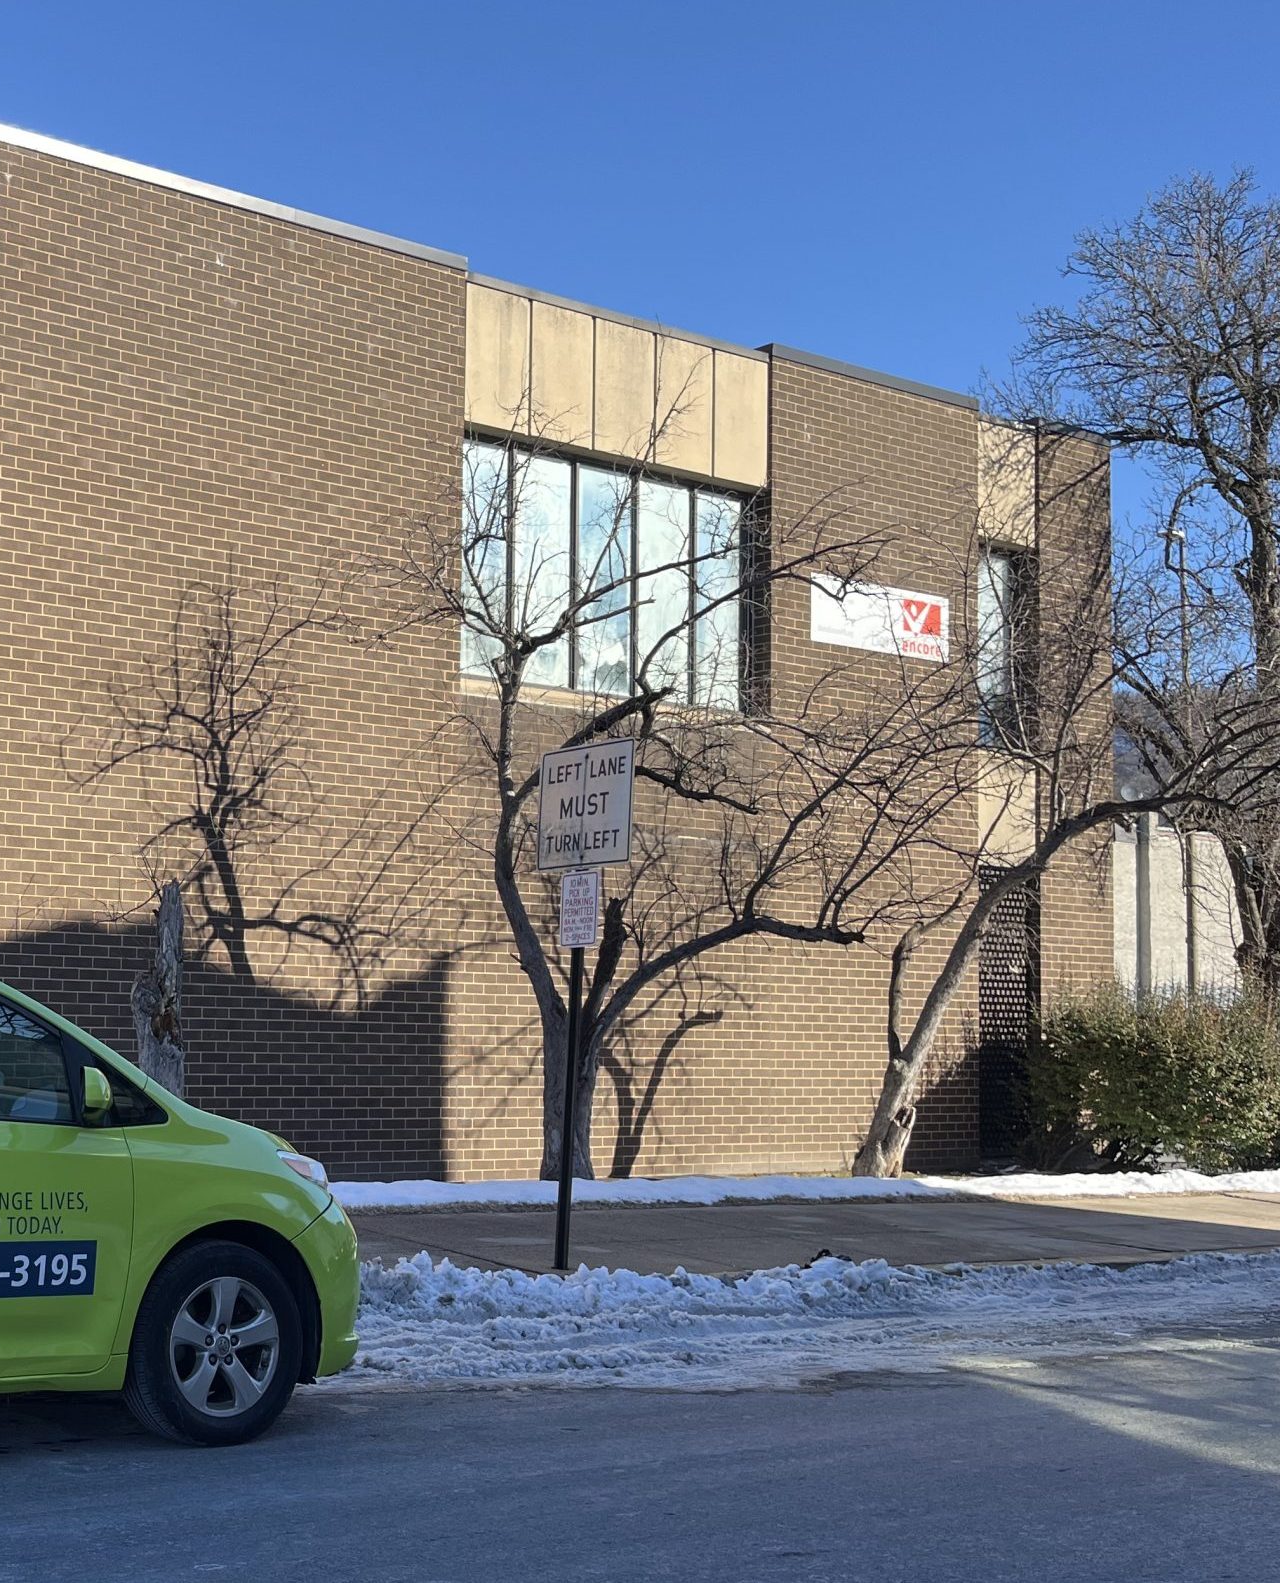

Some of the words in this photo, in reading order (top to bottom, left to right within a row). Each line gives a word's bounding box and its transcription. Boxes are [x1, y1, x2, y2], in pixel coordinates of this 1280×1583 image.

[548, 762, 582, 785] LEFT
[590, 755, 626, 779] LANE
[559, 791, 609, 820] MUST
[546, 833, 580, 855] TURN
[584, 828, 620, 850] LEFT
[565, 897, 594, 907] PARKING
[569, 889, 580, 898] PICK
[583, 888, 590, 897] UP
[564, 906, 594, 918] PERMITTED
[41, 1190, 89, 1213] LIVES,
[7, 1215, 64, 1235] TODAY.
